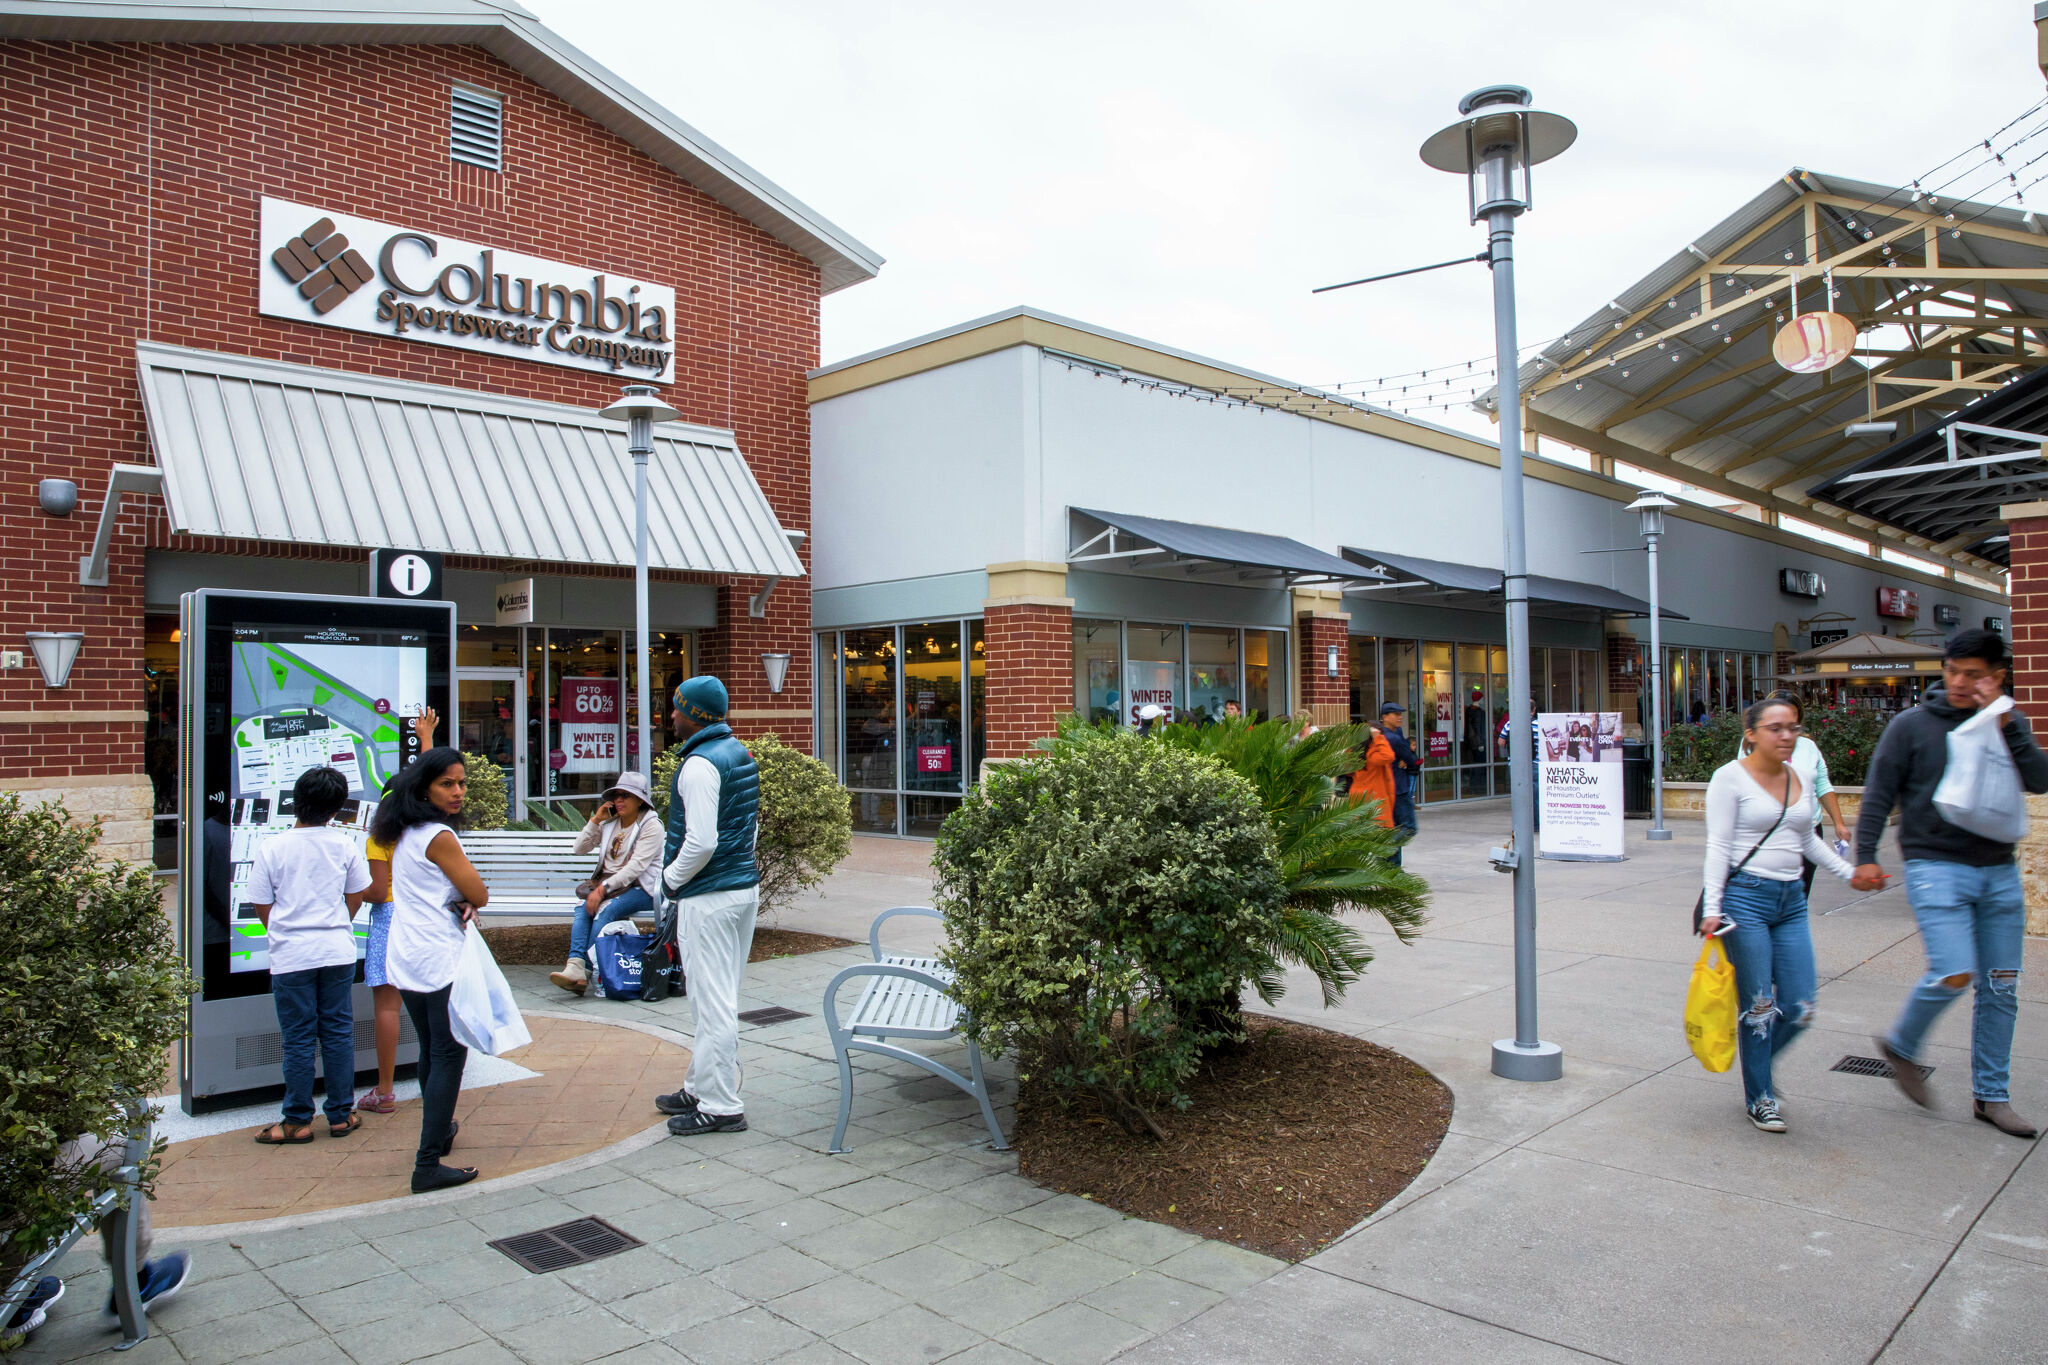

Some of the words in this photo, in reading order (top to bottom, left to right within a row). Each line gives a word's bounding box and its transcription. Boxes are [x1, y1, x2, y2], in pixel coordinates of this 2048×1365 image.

[379, 233, 671, 344] Columbia
[377, 289, 543, 347] Sportswear
[547, 323, 673, 377] Company
[504, 592, 528, 606] Columbia
[576, 686, 587, 694] UP
[589, 686, 601, 694] TO
[1131, 689, 1172, 703] WINTER
[1131, 705, 1172, 726] SE
[573, 733, 615, 742] WINTER
[573, 744, 615, 759] SALE
[1546, 767, 1585, 776] WHAT'S
[1546, 775, 1570, 784] NEW
[1572, 776, 1598, 785] NOW
